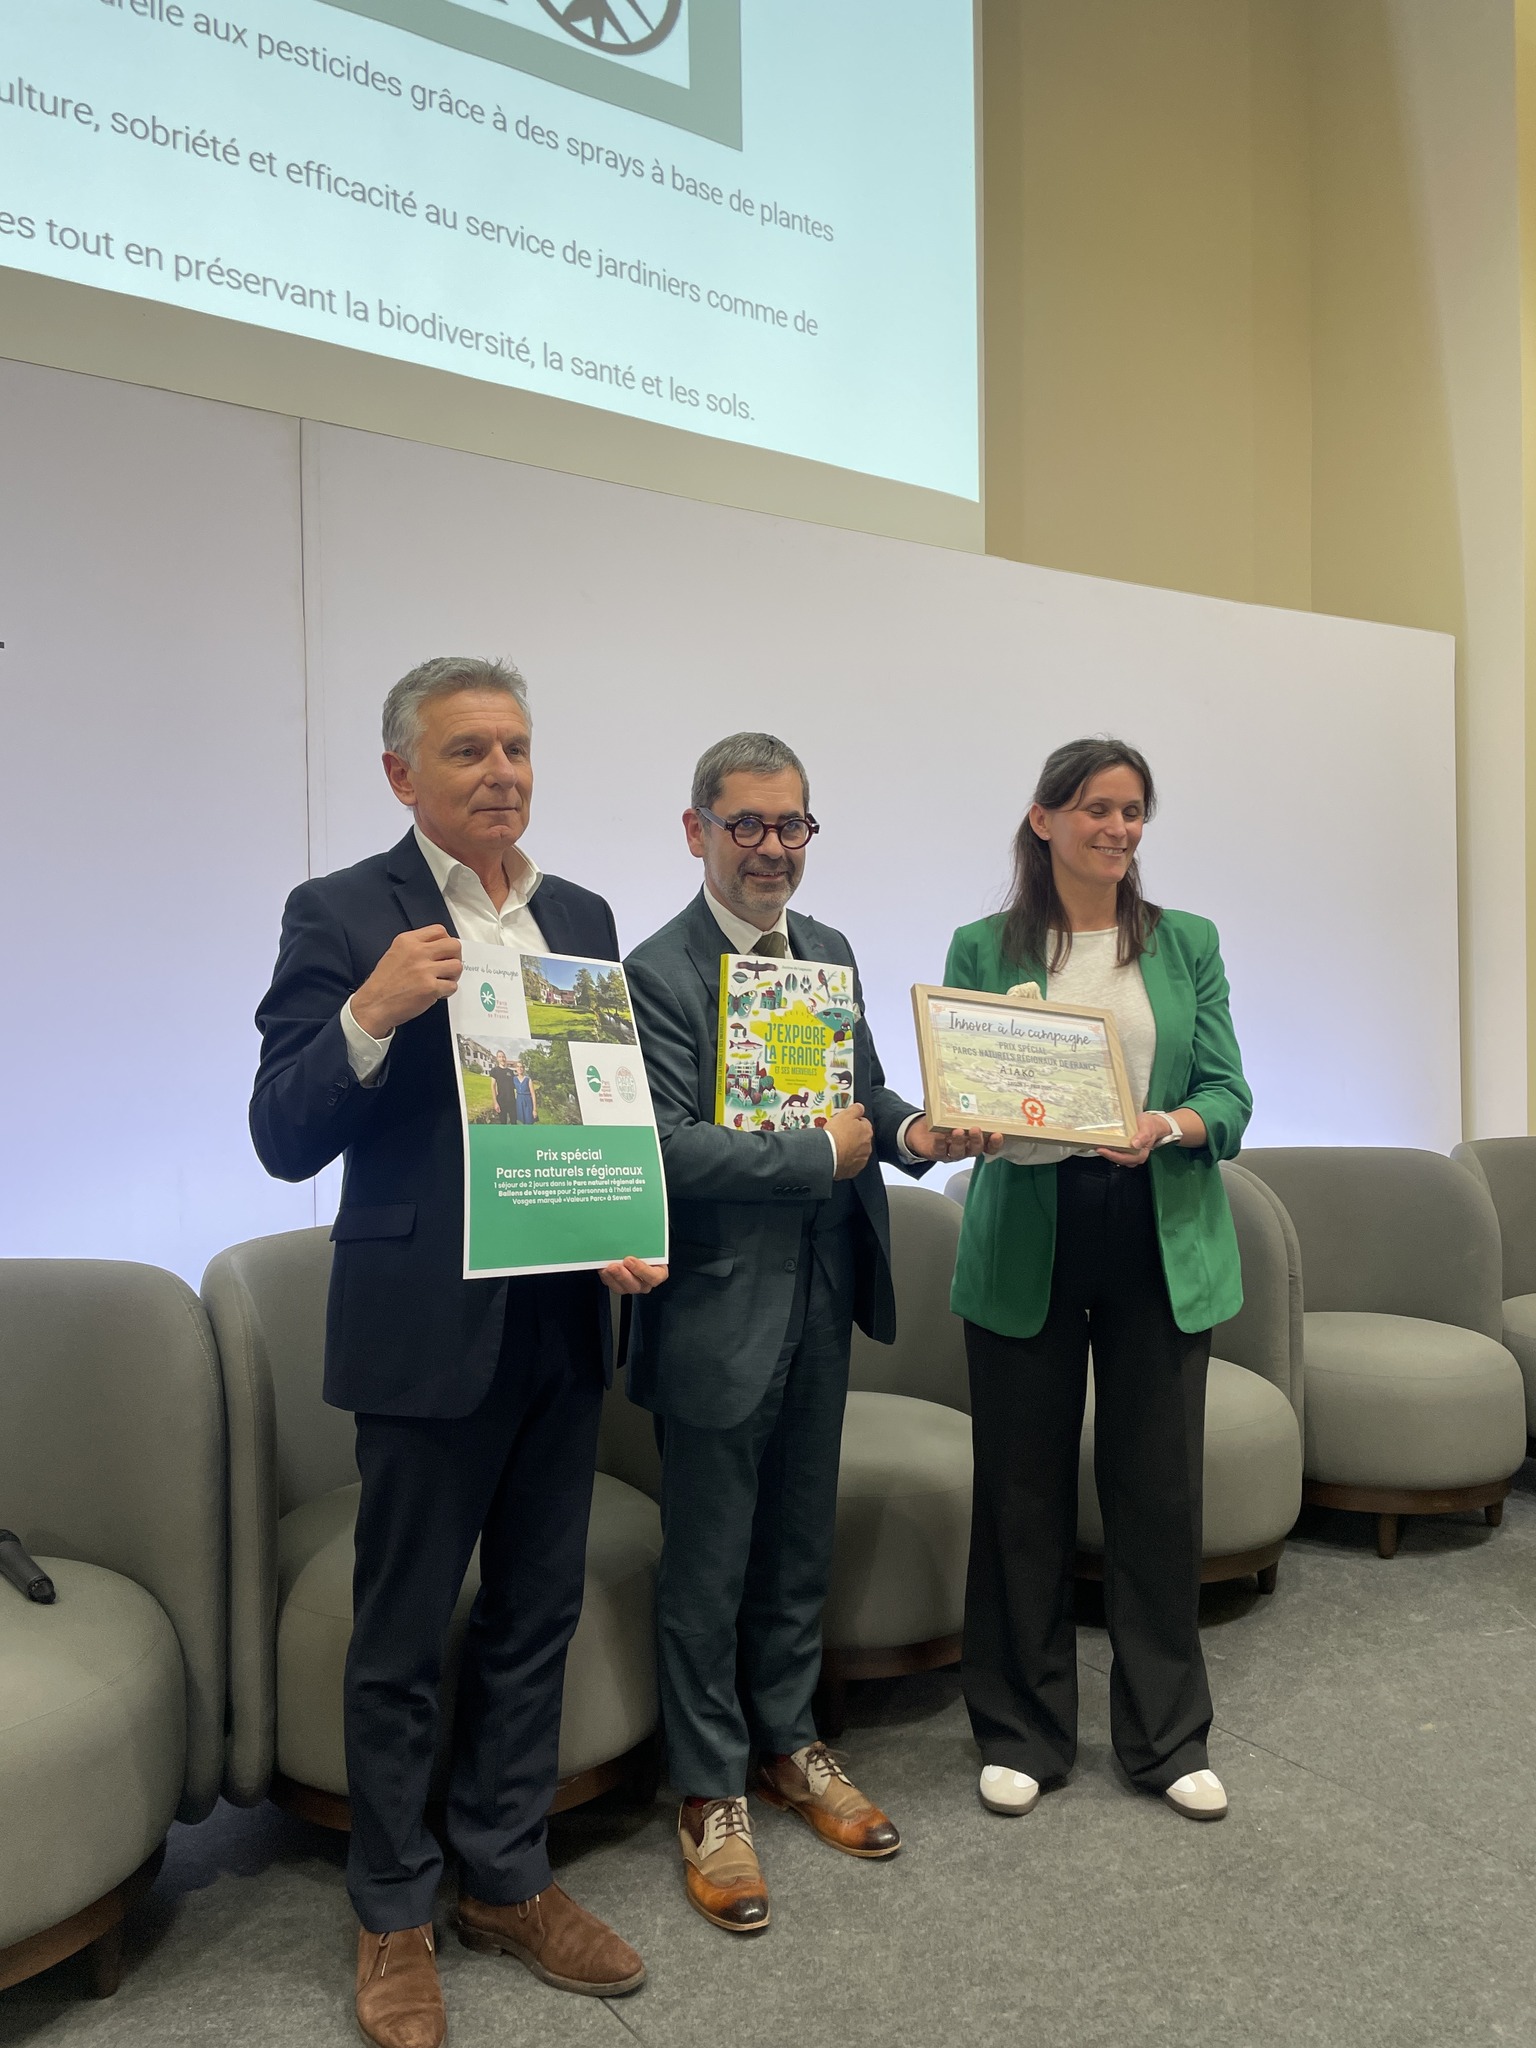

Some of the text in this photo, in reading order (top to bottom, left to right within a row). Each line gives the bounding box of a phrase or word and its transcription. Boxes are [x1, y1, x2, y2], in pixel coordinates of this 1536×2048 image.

[194, 13, 248, 48] aux
[258, 33, 402, 97] pesticides
[411, 85, 485, 124] grâce
[493, 104, 507, 132] à
[515, 115, 559, 150] des
[567, 136, 645, 178] sprays
[652, 158, 664, 185] à
[672, 165, 723, 205] base
[729, 189, 754, 216] de
[761, 202, 834, 242] plantes
[111, 111, 240, 165] sobriété
[249, 151, 278, 178] et
[286, 160, 418, 218] efficacité
[425, 203, 457, 231] au
[466, 214, 555, 258] service
[562, 240, 592, 268] de
[596, 248, 701, 303] jardiniers
[707, 287, 788, 328] comme
[794, 310, 819, 336] de
[46, 219, 114, 260] tout
[125, 243, 163, 270] en
[173, 254, 338, 315] préservant
[346, 290, 369, 322] la
[379, 298, 535, 369] biodiversité,
[544, 342, 563, 371] la
[571, 354, 636, 390] santé
[642, 375, 664, 399] et
[670, 376, 700, 407] les
[706, 391, 755, 421] sols.
[764, 1023, 826, 1046] J'EXPLORE
[949, 1011, 1091, 1053] Innover à la campagne
[764, 1045, 826, 1067] LA FRANCE
[952, 1046, 1097, 1072] PARCS NATURELS RÉGIONAUX DE FRANCE
[999, 1042, 1047, 1055] PRIX SPÉCIAL
[536, 1149, 602, 1164] Prix spécial
[496, 1164, 643, 1179] Parcs naturels régionaux
[498, 1182, 518, 1190] séjour
[533, 1181, 549, 1189] jours
[610, 1178, 634, 1187] régional
[577, 1188, 608, 1196] personnes
[512, 1198, 536, 1206] Vosges
